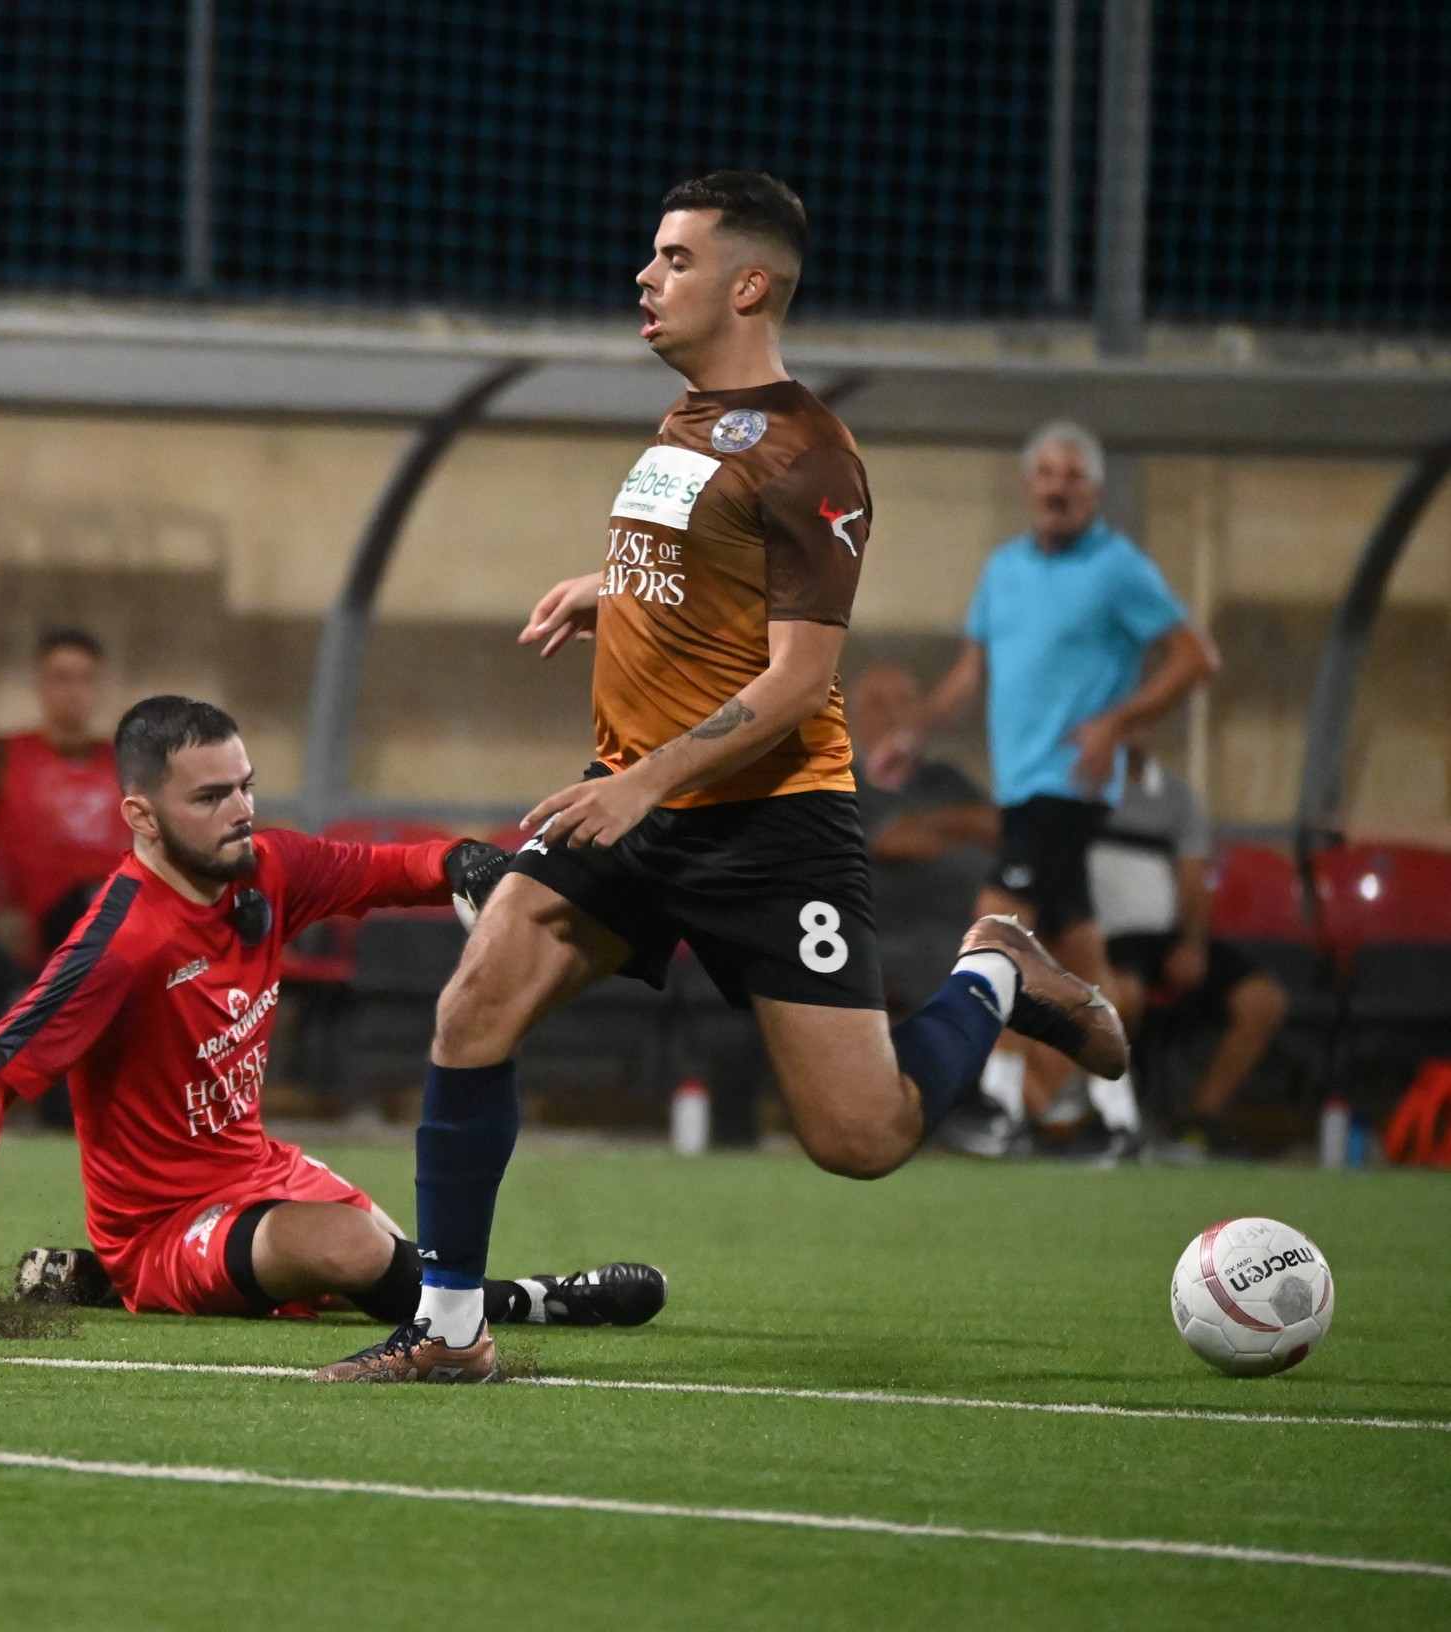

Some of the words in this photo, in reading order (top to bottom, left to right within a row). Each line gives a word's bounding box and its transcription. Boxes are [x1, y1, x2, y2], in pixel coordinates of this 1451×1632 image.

[625, 462, 701, 505] elbee's
[658, 542, 682, 561] OF
[798, 900, 849, 974] 8
[1229, 1246, 1316, 1292] macron
[1236, 1256, 1253, 1270] DEW
